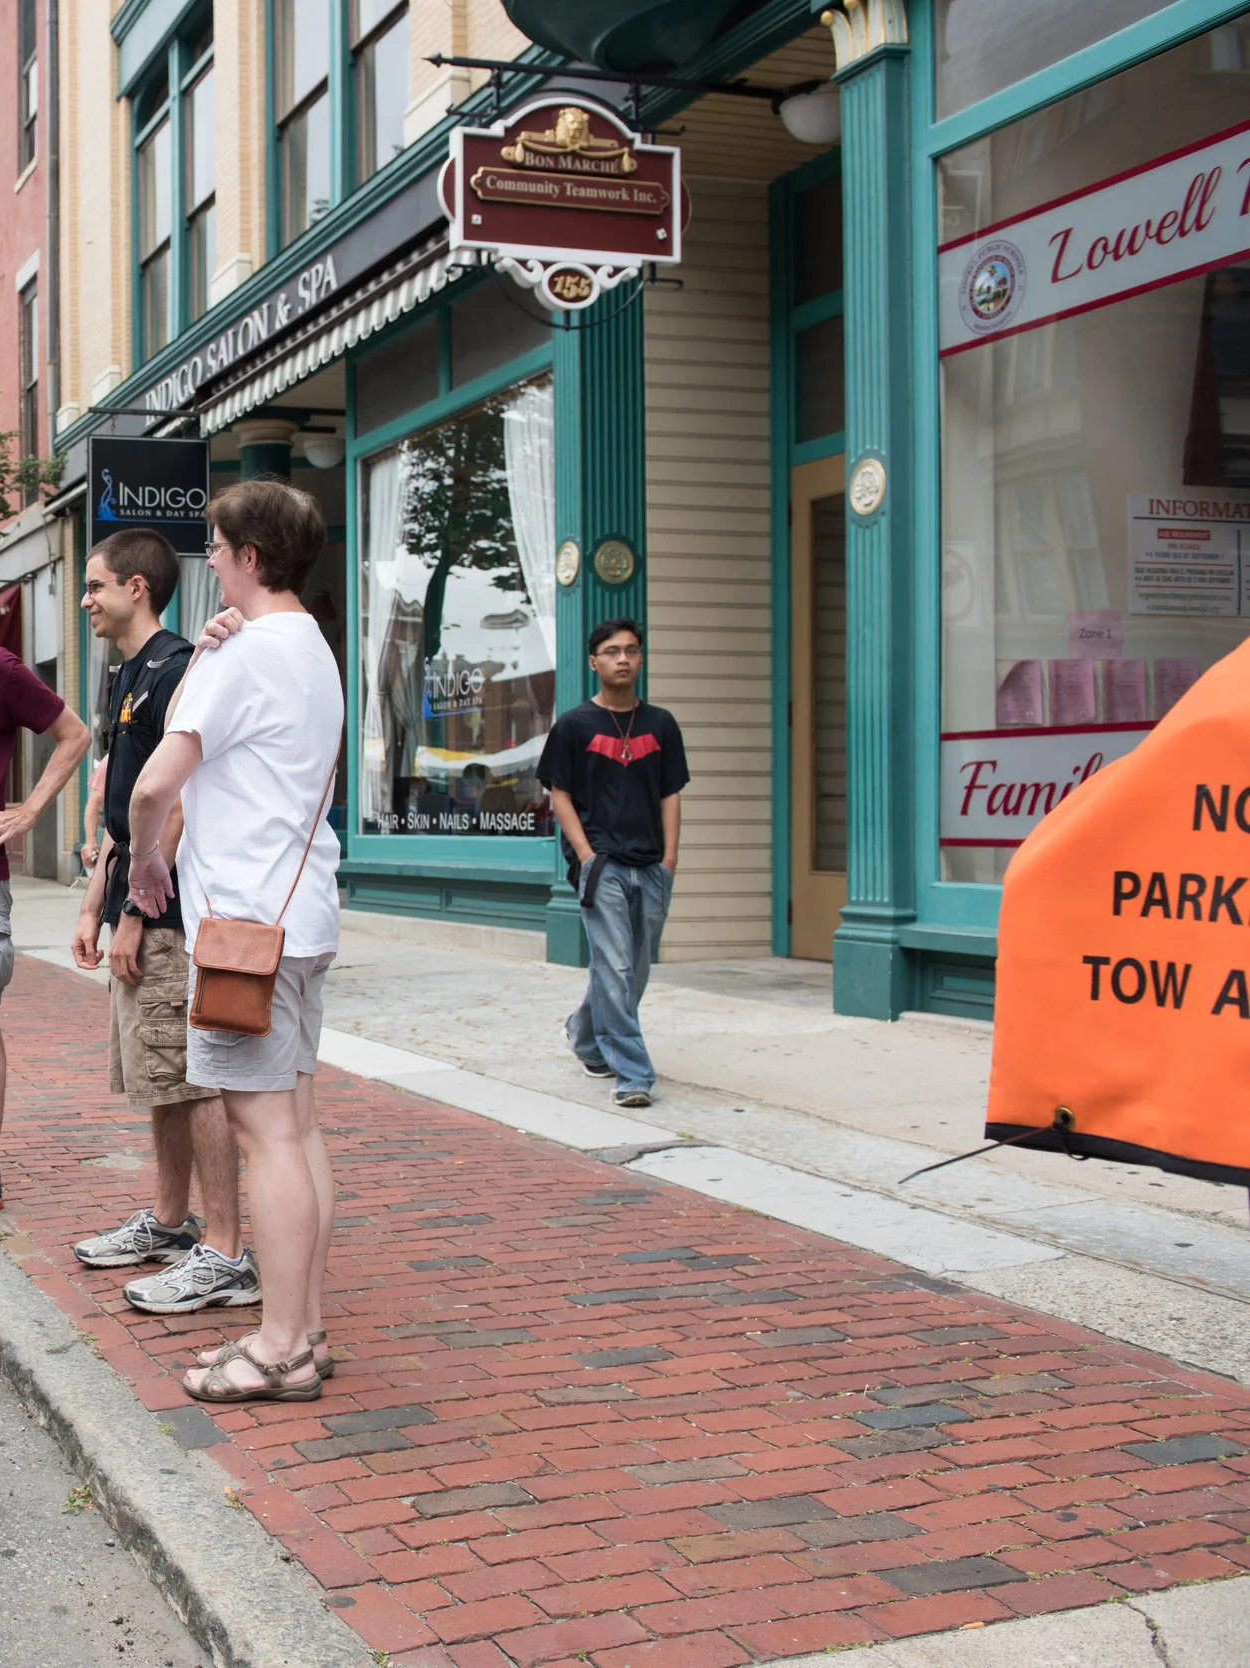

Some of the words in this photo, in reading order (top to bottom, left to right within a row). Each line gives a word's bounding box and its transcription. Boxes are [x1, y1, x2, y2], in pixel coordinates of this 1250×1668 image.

[524, 151, 554, 168] BON
[558, 154, 619, 173] MARCHÉ
[486, 175, 560, 198] Community
[564, 182, 630, 200] Teamwork
[633, 189, 657, 203] Inc.
[1048, 166, 1223, 284] Lowell
[553, 275, 591, 299] 155
[145, 356, 202, 428] INDIGO
[207, 302, 269, 378] SALON
[275, 293, 292, 329] &
[298, 254, 338, 314] SPA
[119, 482, 206, 509] INDIGO
[120, 508, 151, 516] SALON
[166, 510, 185, 518] DAY
[1079, 628, 1104, 640] Zone
[1106, 628, 1113, 640] 1
[433, 668, 483, 699] INDIGO
[377, 812, 399, 830] HAIR
[407, 812, 430, 830] SKIN
[439, 812, 469, 830] NAILS
[480, 812, 535, 830] MASSAGE
[1112, 870, 1250, 926] PARK
[1083, 955, 1193, 1010] TOW
